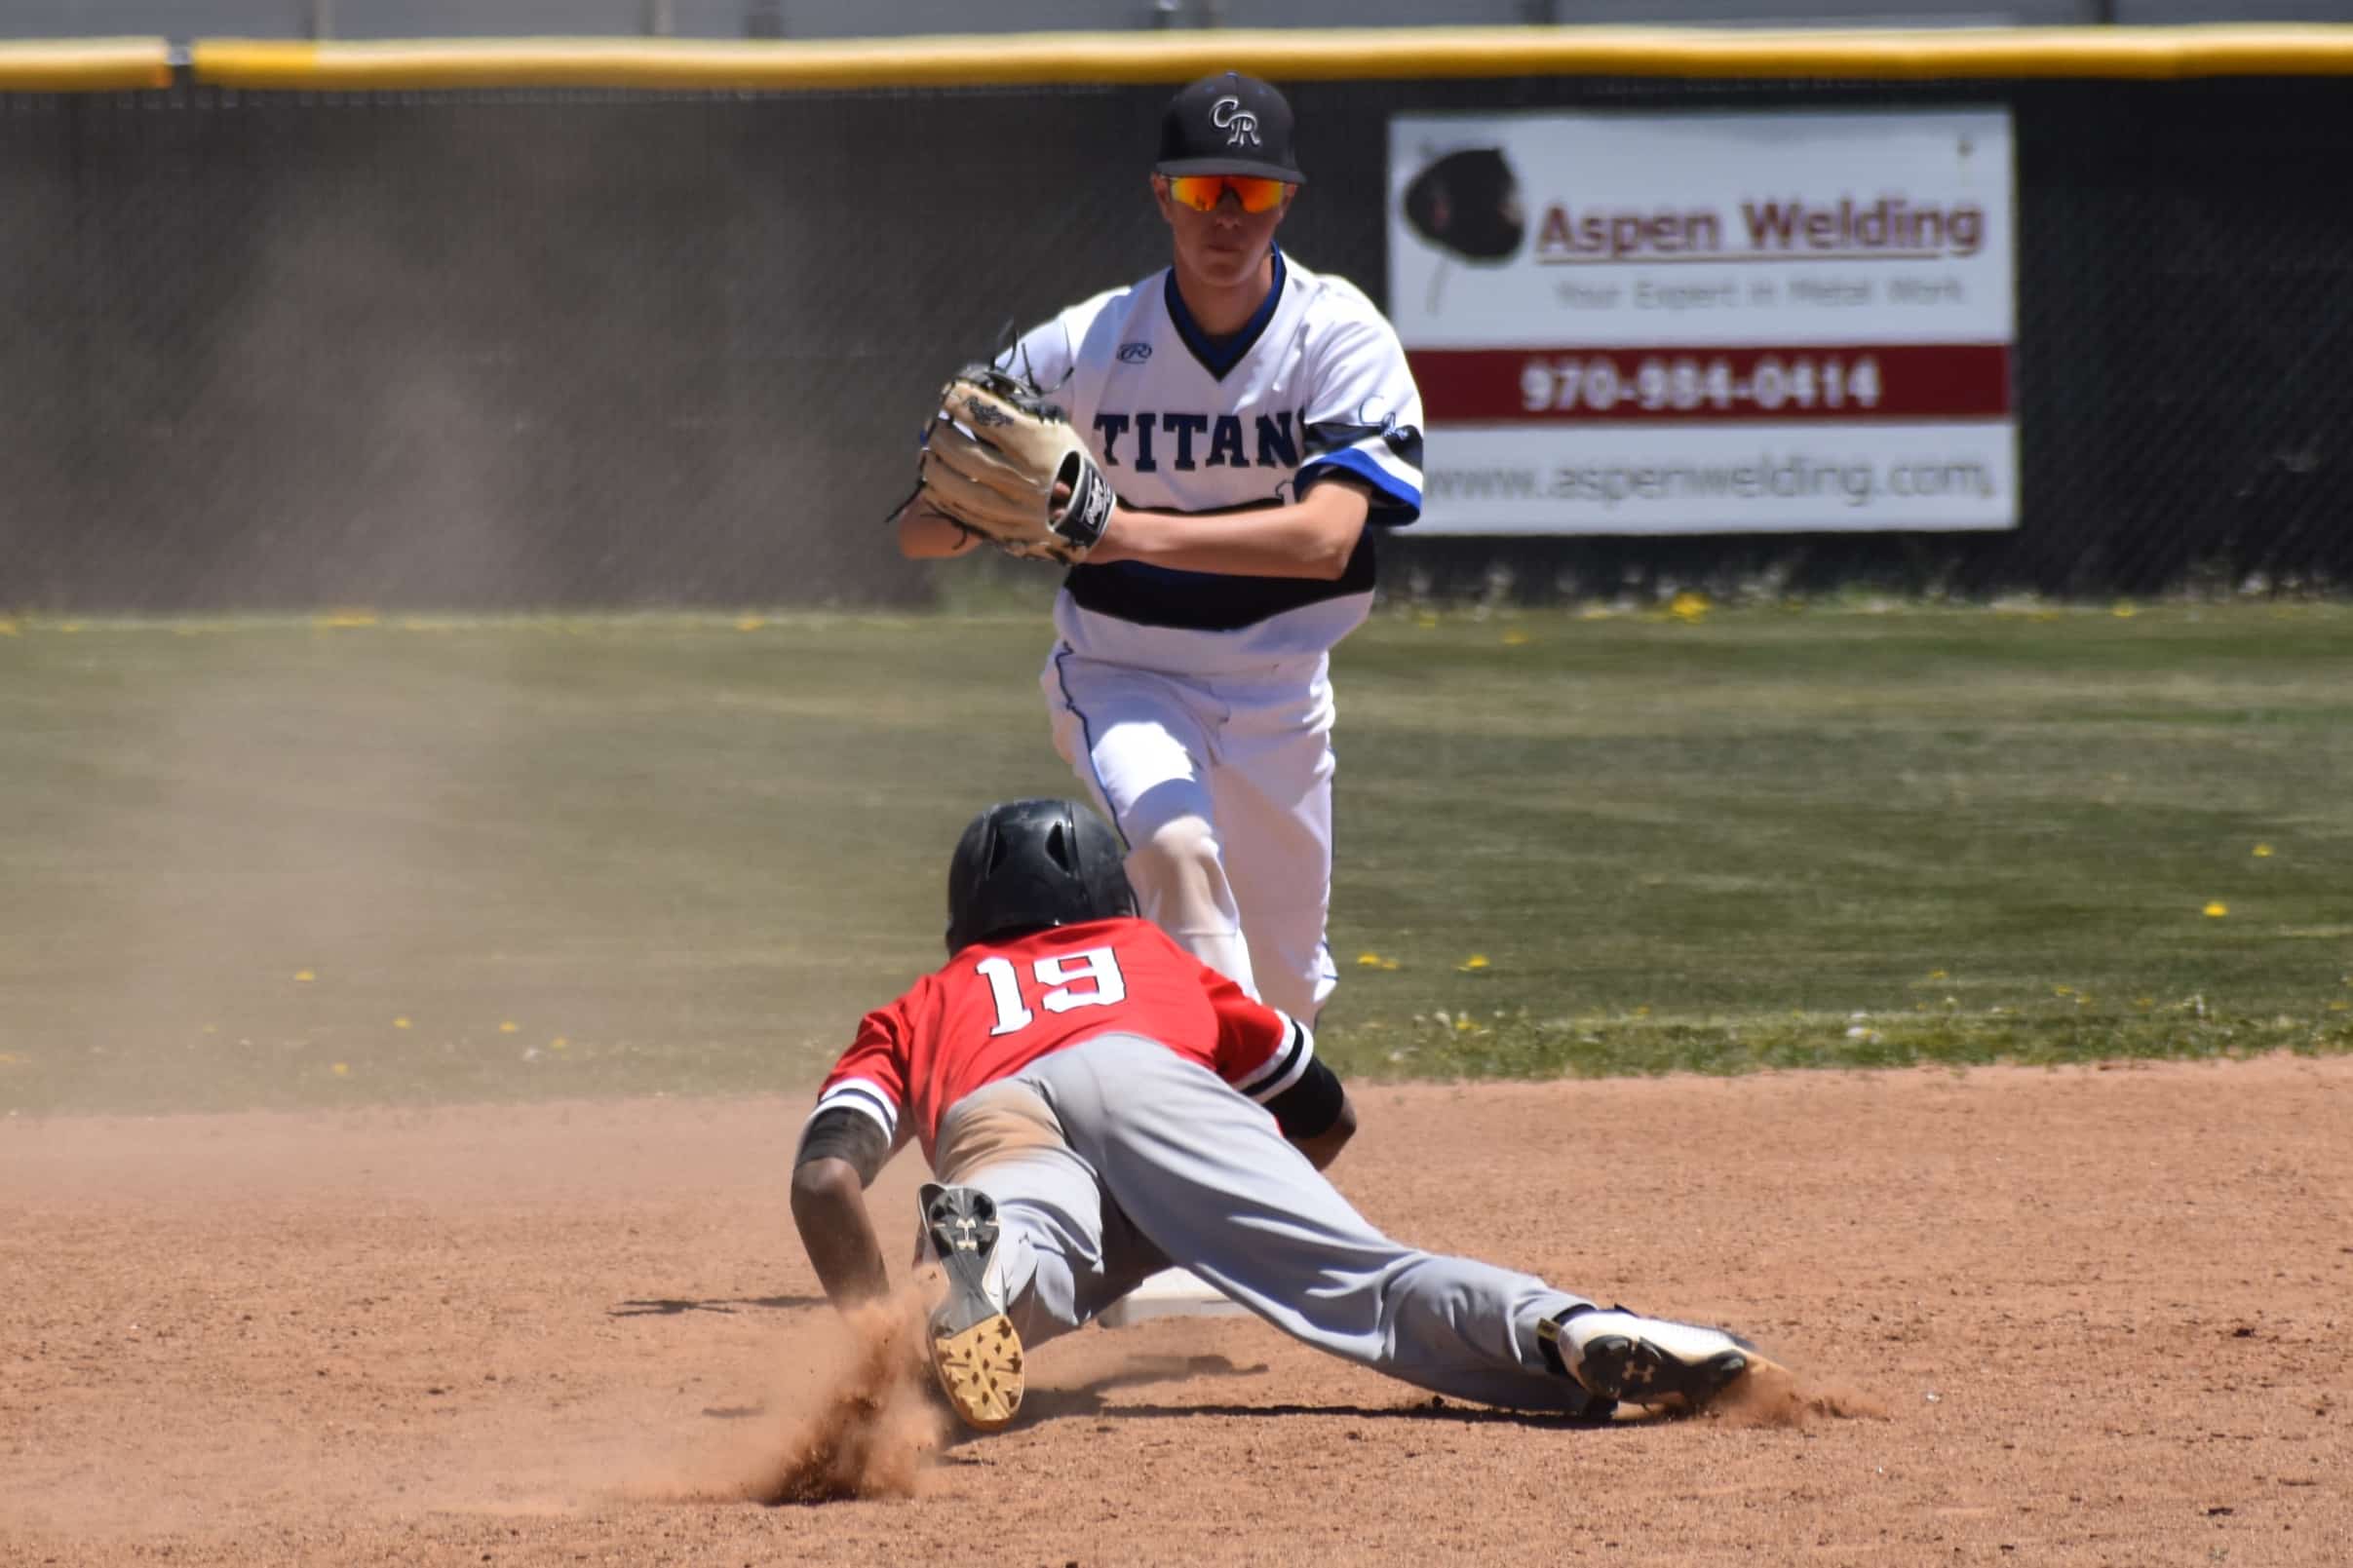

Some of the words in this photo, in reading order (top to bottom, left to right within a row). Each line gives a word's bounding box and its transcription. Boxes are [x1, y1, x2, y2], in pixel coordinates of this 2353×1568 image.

[1209, 96, 1262, 146] CR
[1536, 202, 1721, 258] Aspen
[1741, 198, 1983, 257] Welding
[1093, 406, 1306, 473] TITAN
[975, 945, 1127, 1038] 19
